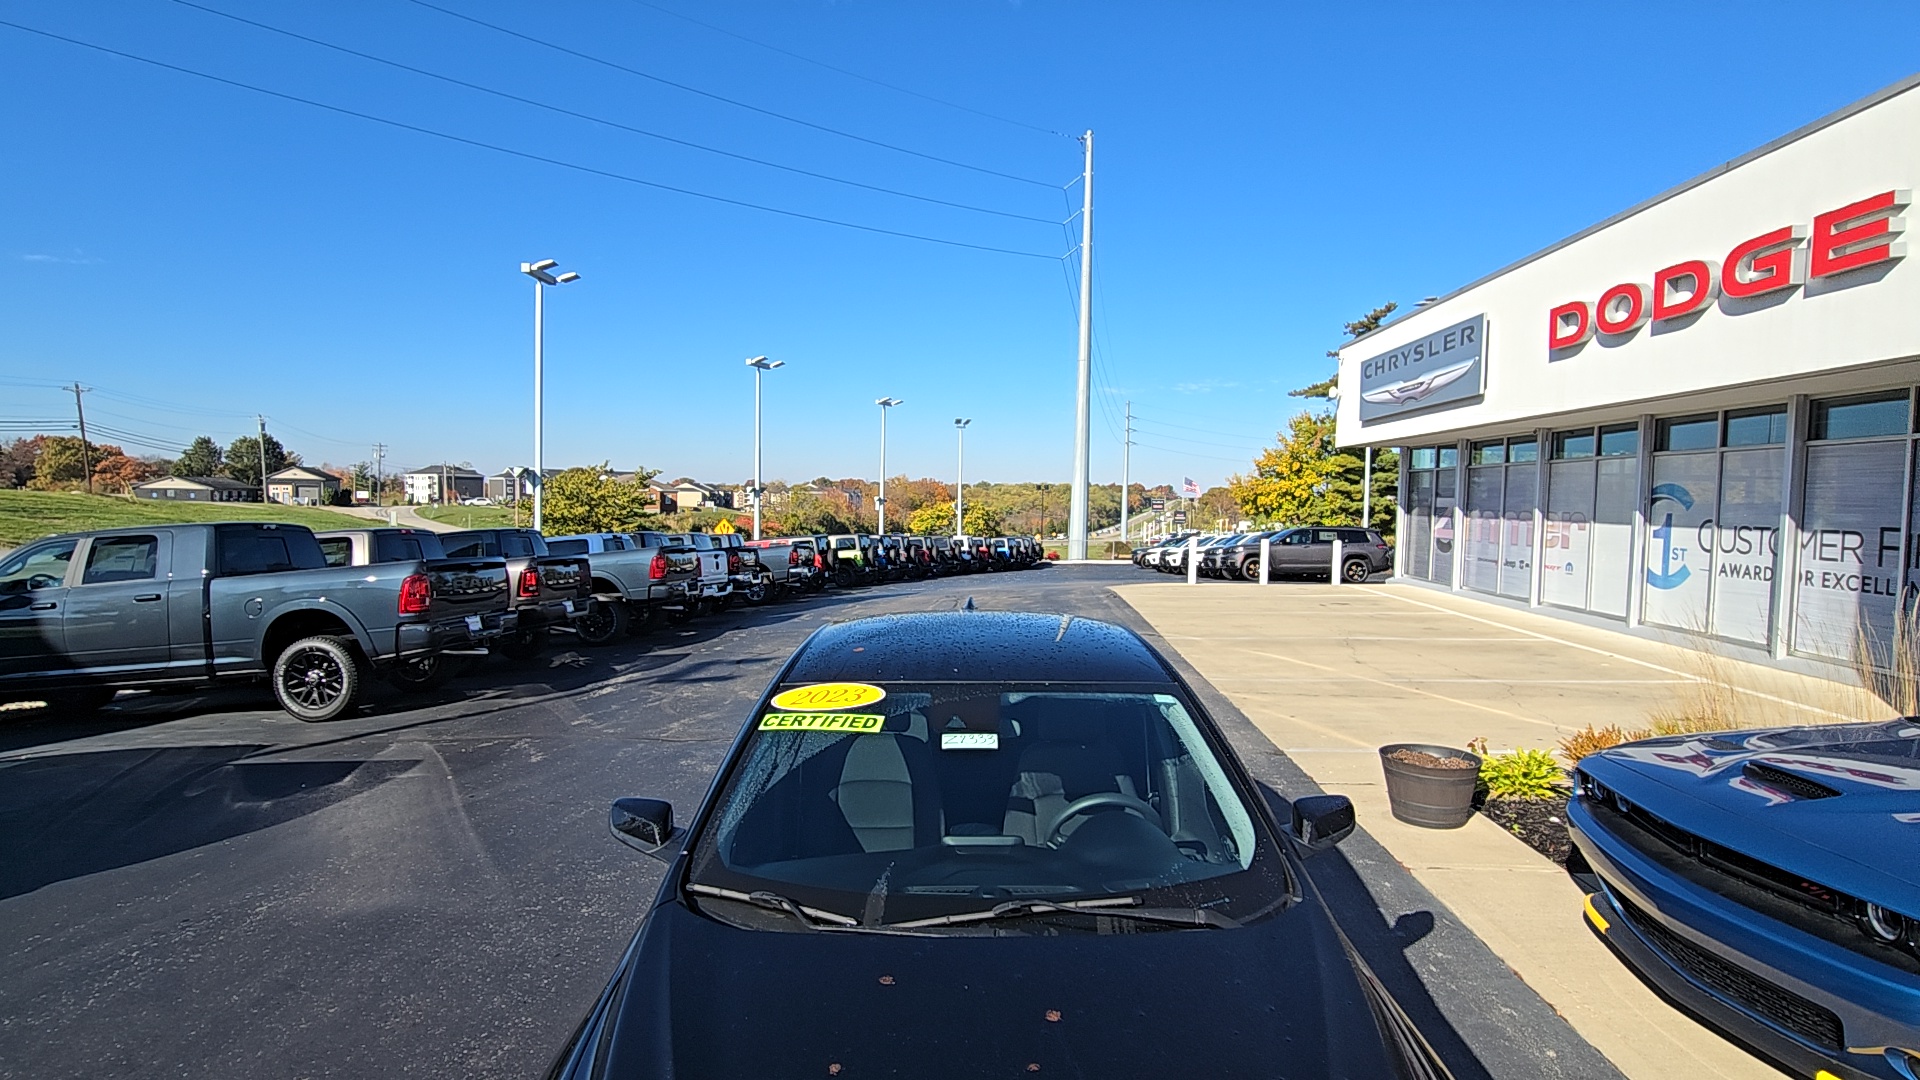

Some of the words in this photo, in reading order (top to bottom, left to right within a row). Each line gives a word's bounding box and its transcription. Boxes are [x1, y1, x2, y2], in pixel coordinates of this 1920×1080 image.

[1549, 188, 1905, 351] DODGE
[1363, 324, 1475, 380] CHRYSLER
[1433, 497, 1587, 551] Zmmer
[452, 576, 494, 590] RAM
[1718, 562, 1775, 582] AWARD
[1821, 570, 1920, 599] EXCELLN
[789, 688, 868, 706] 2023
[763, 715, 878, 729] CERTIFIED
